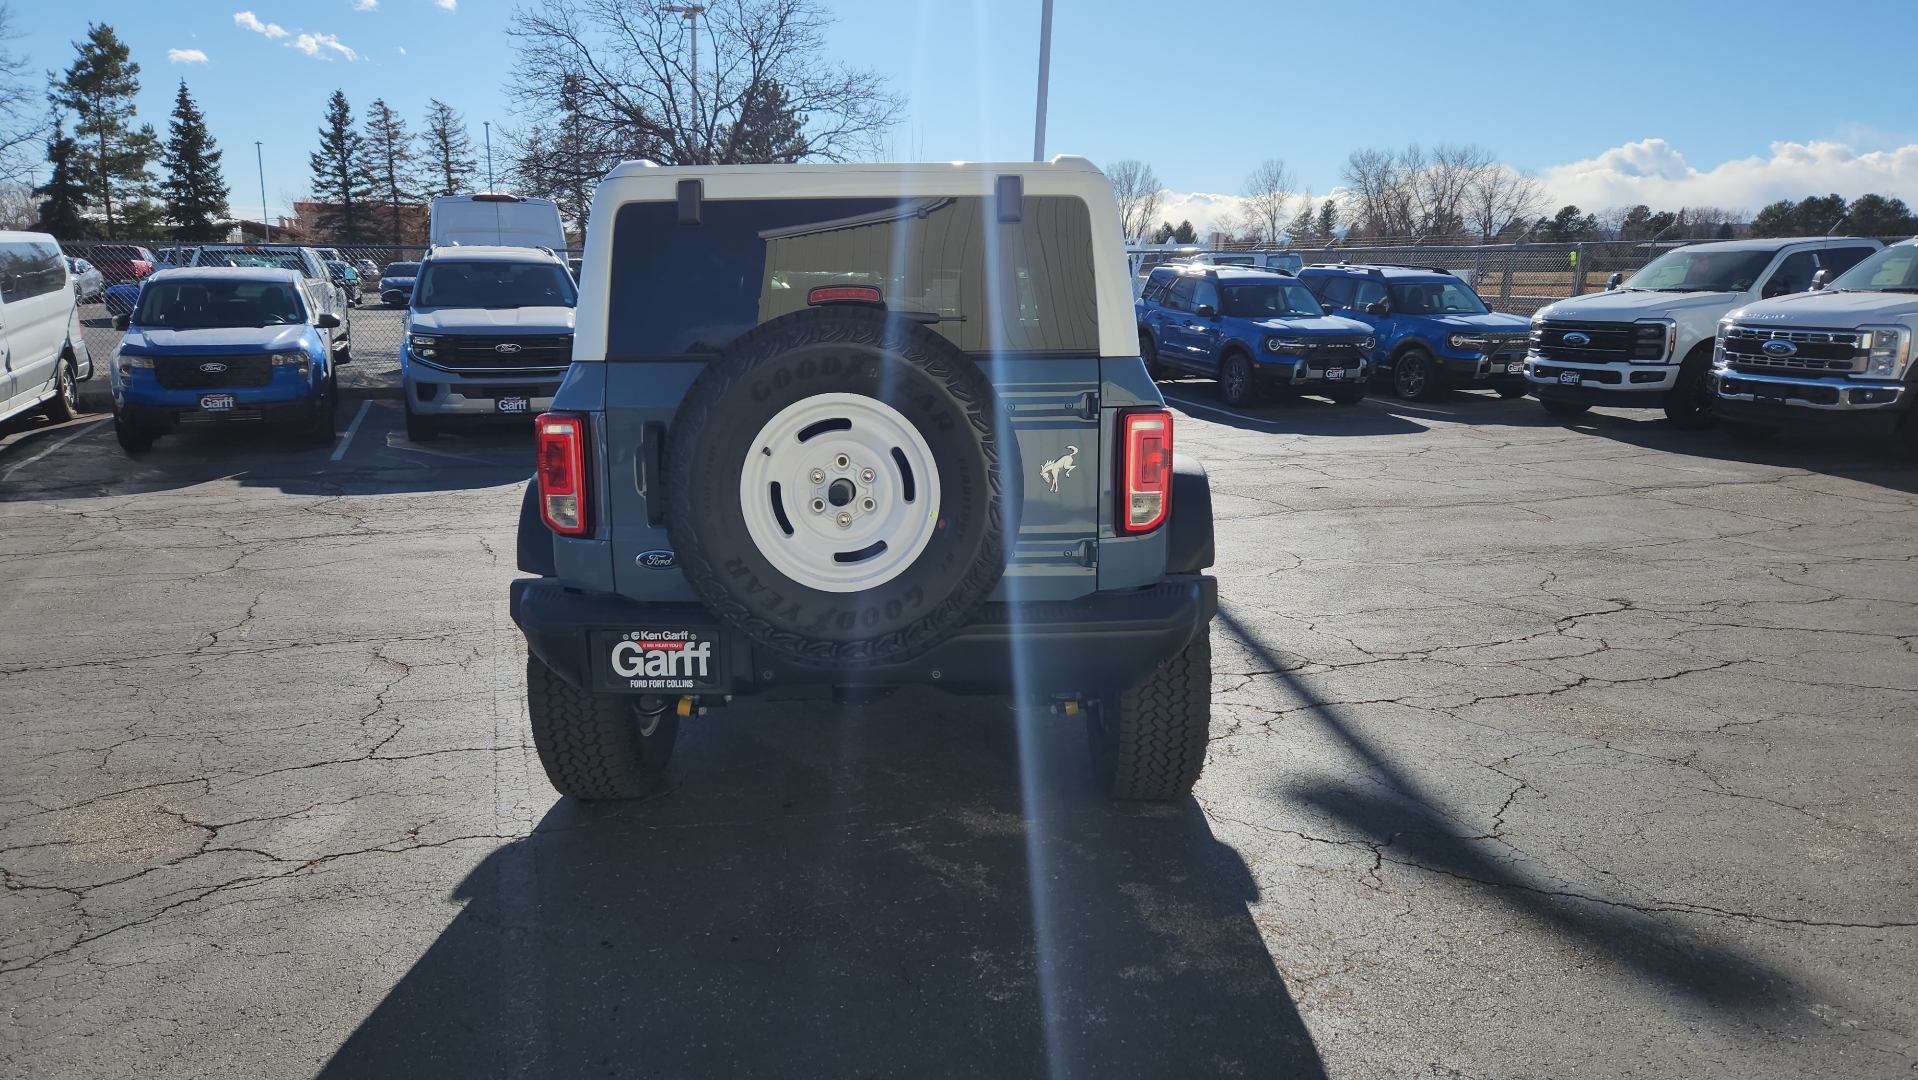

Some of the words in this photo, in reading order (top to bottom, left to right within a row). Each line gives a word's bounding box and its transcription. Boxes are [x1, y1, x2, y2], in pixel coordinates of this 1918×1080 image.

[1325, 369, 1345, 378] Garff
[1507, 364, 1525, 373] Garff
[1560, 372, 1580, 383] Garff
[200, 396, 234, 409] Garff
[498, 399, 527, 411] Garff
[646, 554, 673, 566] Ford
[640, 630, 662, 640] Ken
[662, 630, 688, 640] Garff
[611, 640, 711, 677] Garff
[630, 679, 647, 688] FORD
[648, 679, 665, 688] FORT
[666, 679, 694, 688] COLLINS
